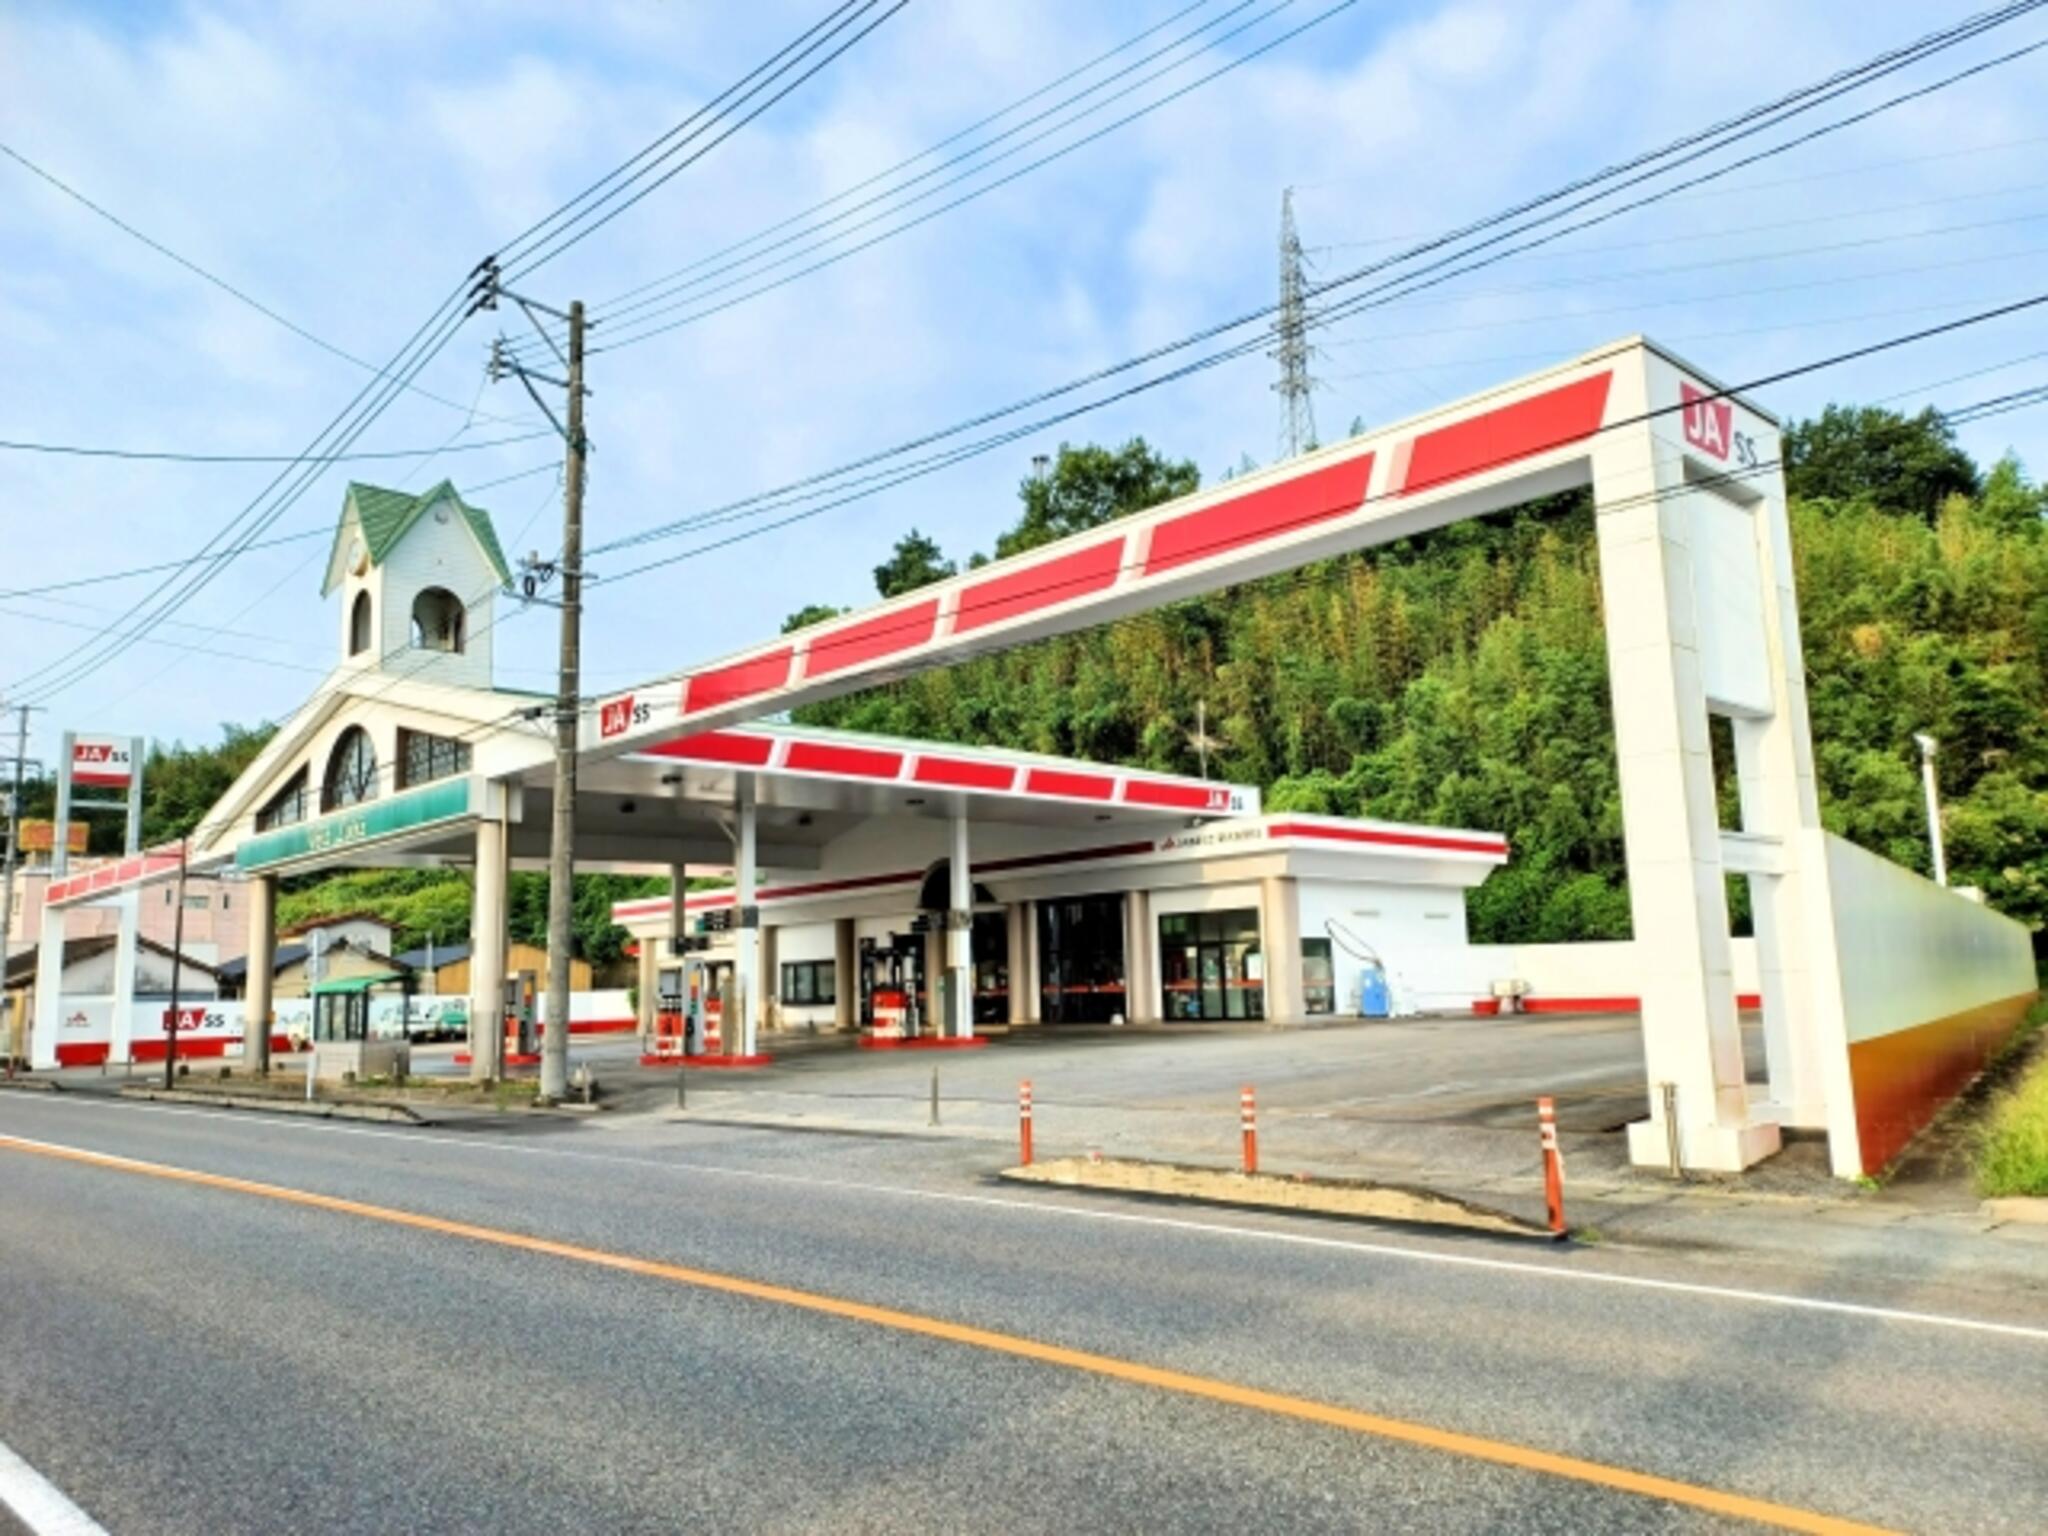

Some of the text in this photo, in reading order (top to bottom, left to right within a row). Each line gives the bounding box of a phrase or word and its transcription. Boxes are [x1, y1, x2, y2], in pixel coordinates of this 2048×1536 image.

[1689, 396, 1757, 467] JA SS
[603, 702, 651, 733] JA SS
[76, 746, 102, 761] JA
[204, 1014, 225, 1028] SS
